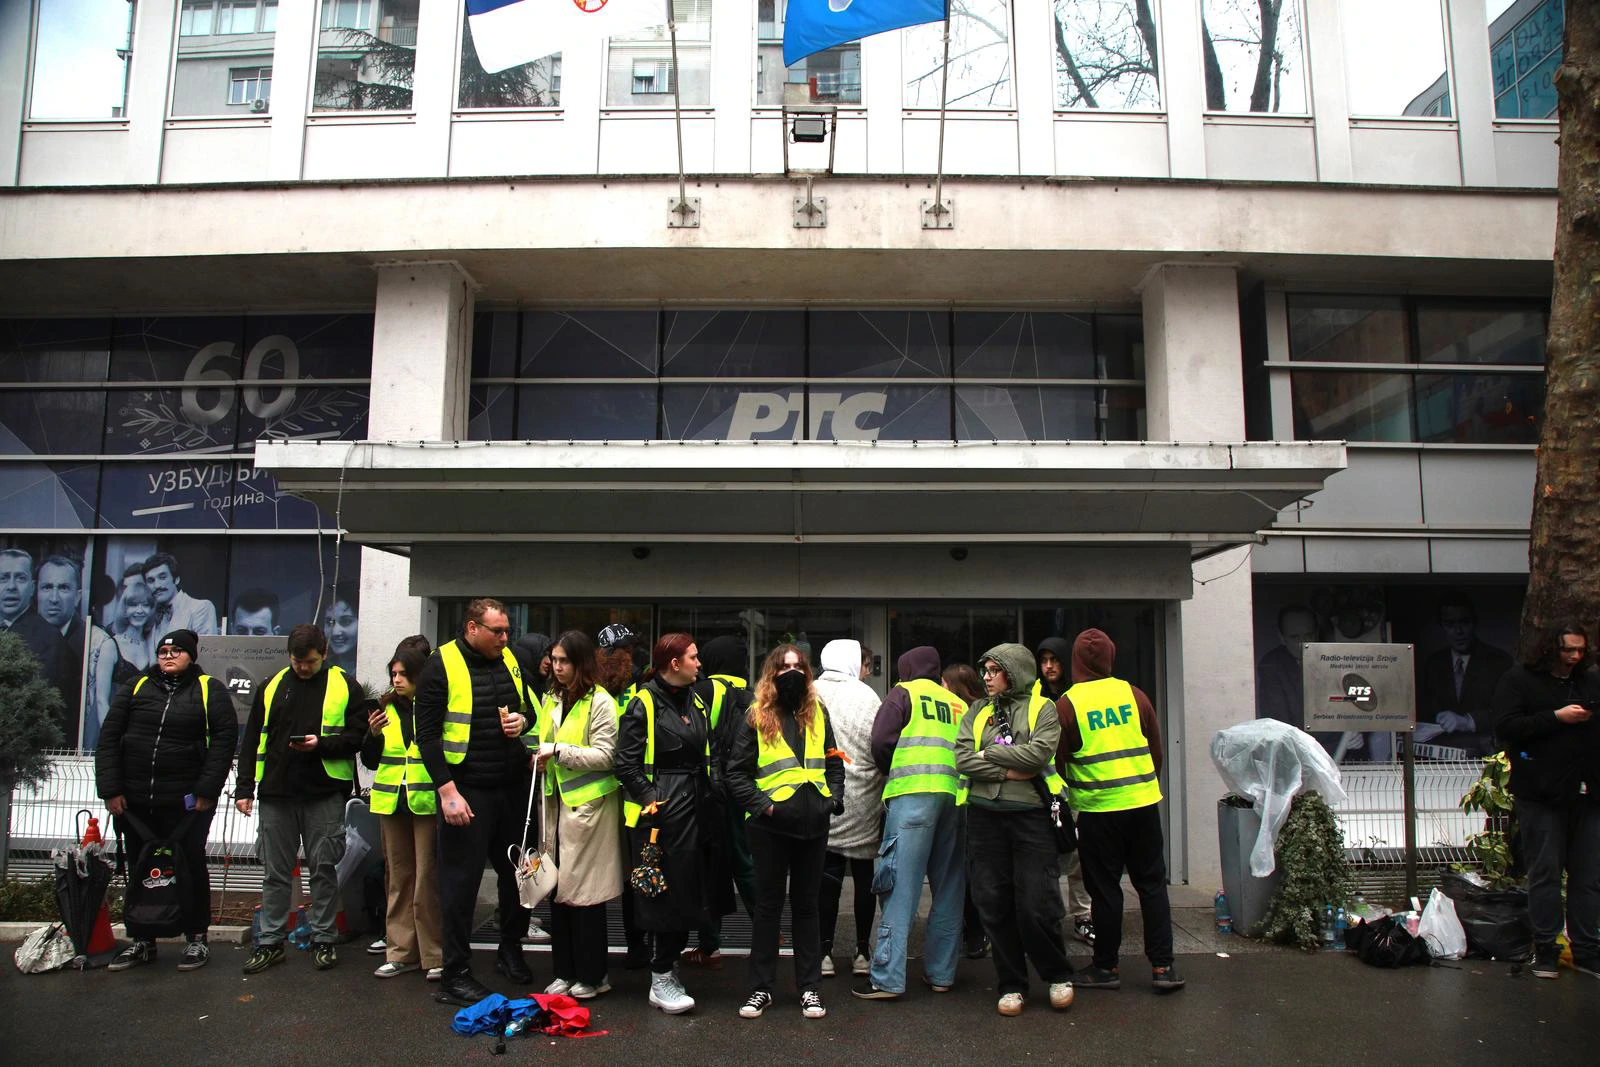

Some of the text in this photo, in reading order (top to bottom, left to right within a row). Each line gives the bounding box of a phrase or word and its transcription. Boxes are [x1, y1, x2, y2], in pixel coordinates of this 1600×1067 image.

[181, 334, 299, 425] 60
[203, 491, 265, 510] година
[1348, 686, 1371, 696] RTS
[1087, 704, 1132, 731] RAF
